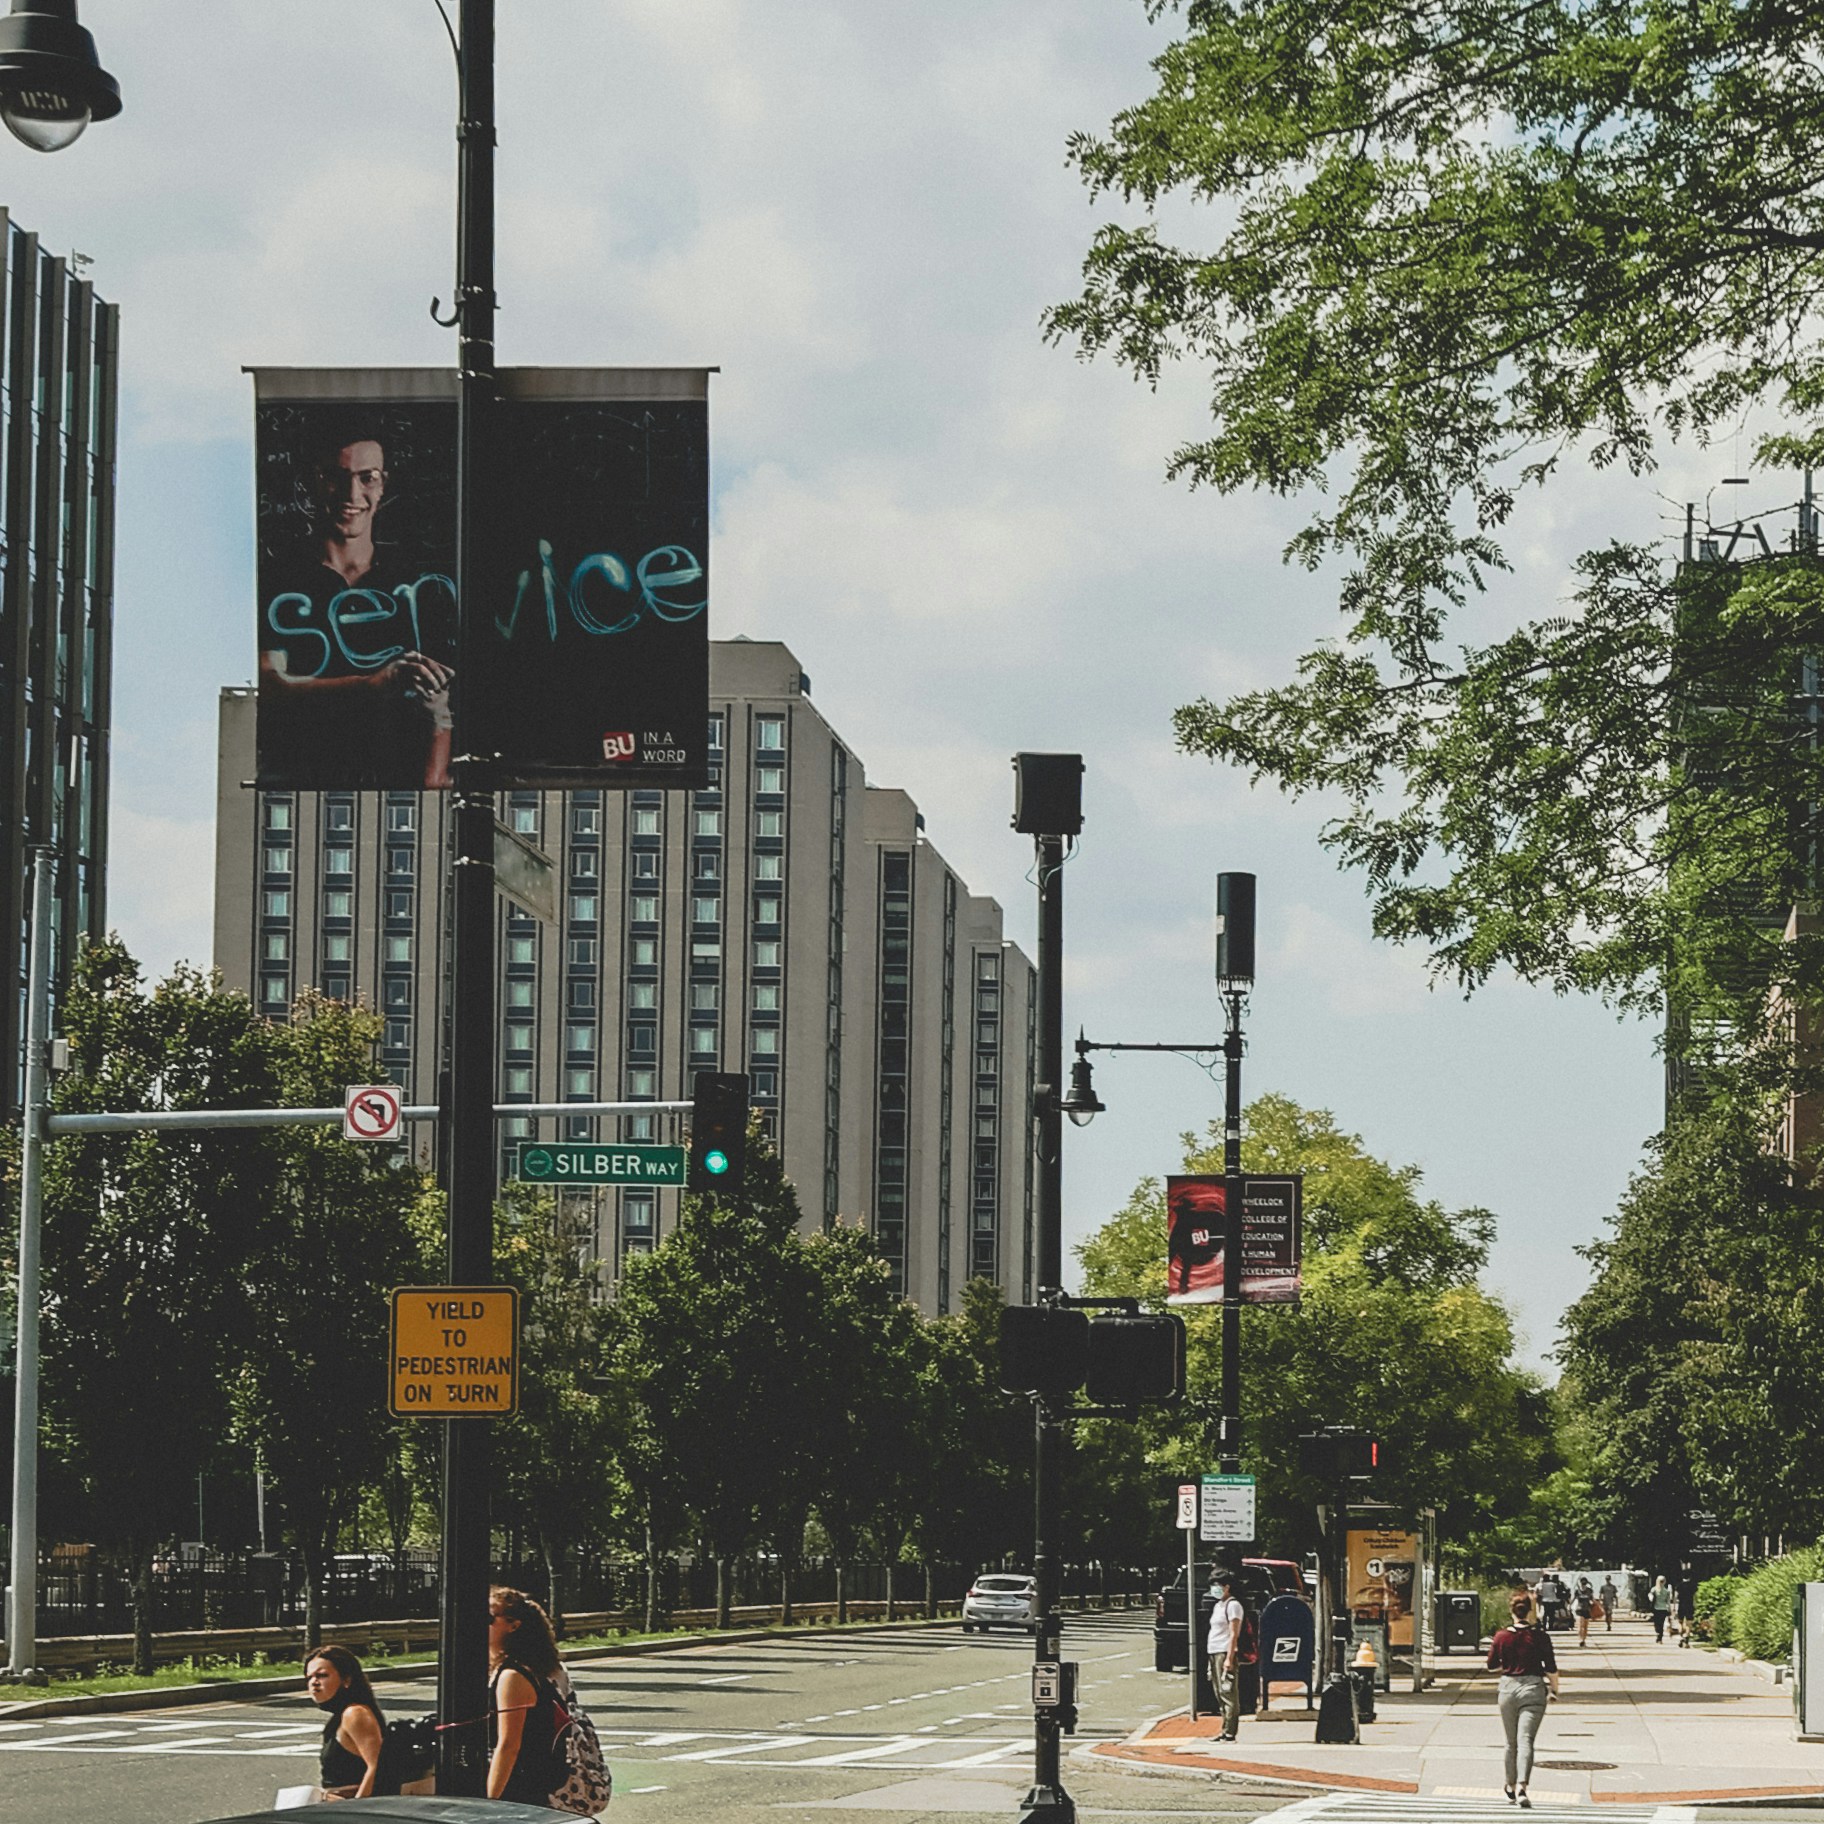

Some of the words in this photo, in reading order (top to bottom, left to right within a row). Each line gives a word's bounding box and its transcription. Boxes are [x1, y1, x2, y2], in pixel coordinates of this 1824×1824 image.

[643, 732, 658, 744] IN
[664, 732, 674, 744] A
[602, 733, 635, 760] BU
[643, 749, 686, 762] WORD
[555, 1154, 641, 1175] SILBER
[646, 1163, 678, 1176] WAY
[1242, 1198, 1284, 1206] WHEELOCK
[1192, 1229, 1209, 1244] BU
[1242, 1233, 1284, 1241] EDUCATION
[1240, 1268, 1296, 1276] DEVELOPMENT
[426, 1301, 484, 1320] YIELD
[442, 1329, 466, 1347] TO
[398, 1357, 511, 1375] PEDESTRIAN
[404, 1384, 431, 1402] ON
[446, 1384, 498, 1403] TURN
